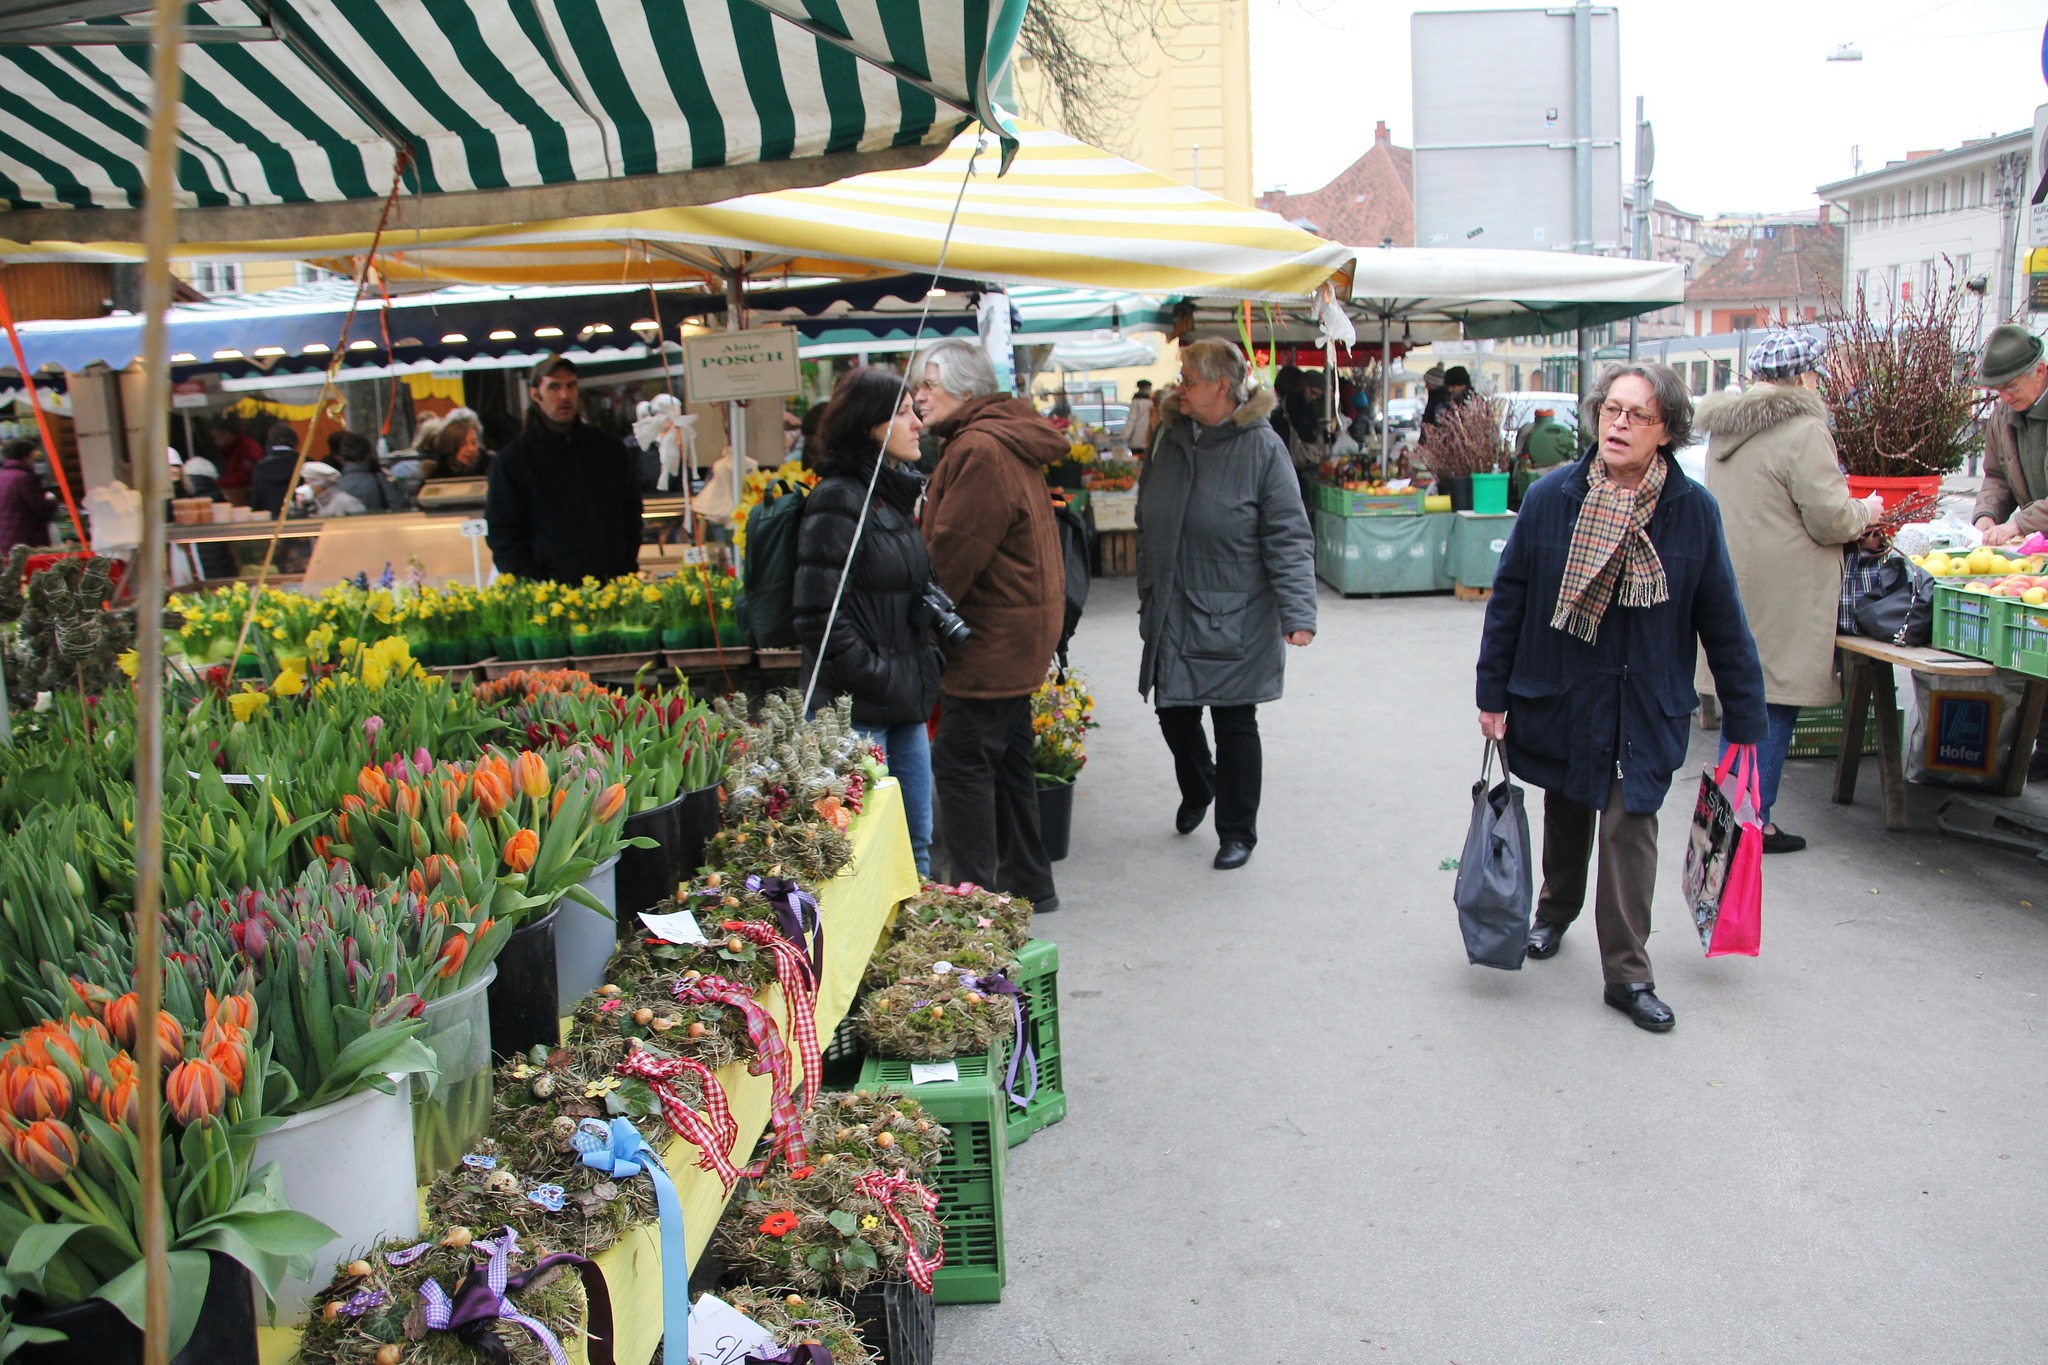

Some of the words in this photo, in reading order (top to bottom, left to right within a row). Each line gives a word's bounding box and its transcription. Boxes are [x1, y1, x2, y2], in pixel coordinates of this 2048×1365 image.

[722, 343, 760, 352] Alois
[701, 351, 783, 368] POSCH
[1939, 745, 1982, 761] Hofer
